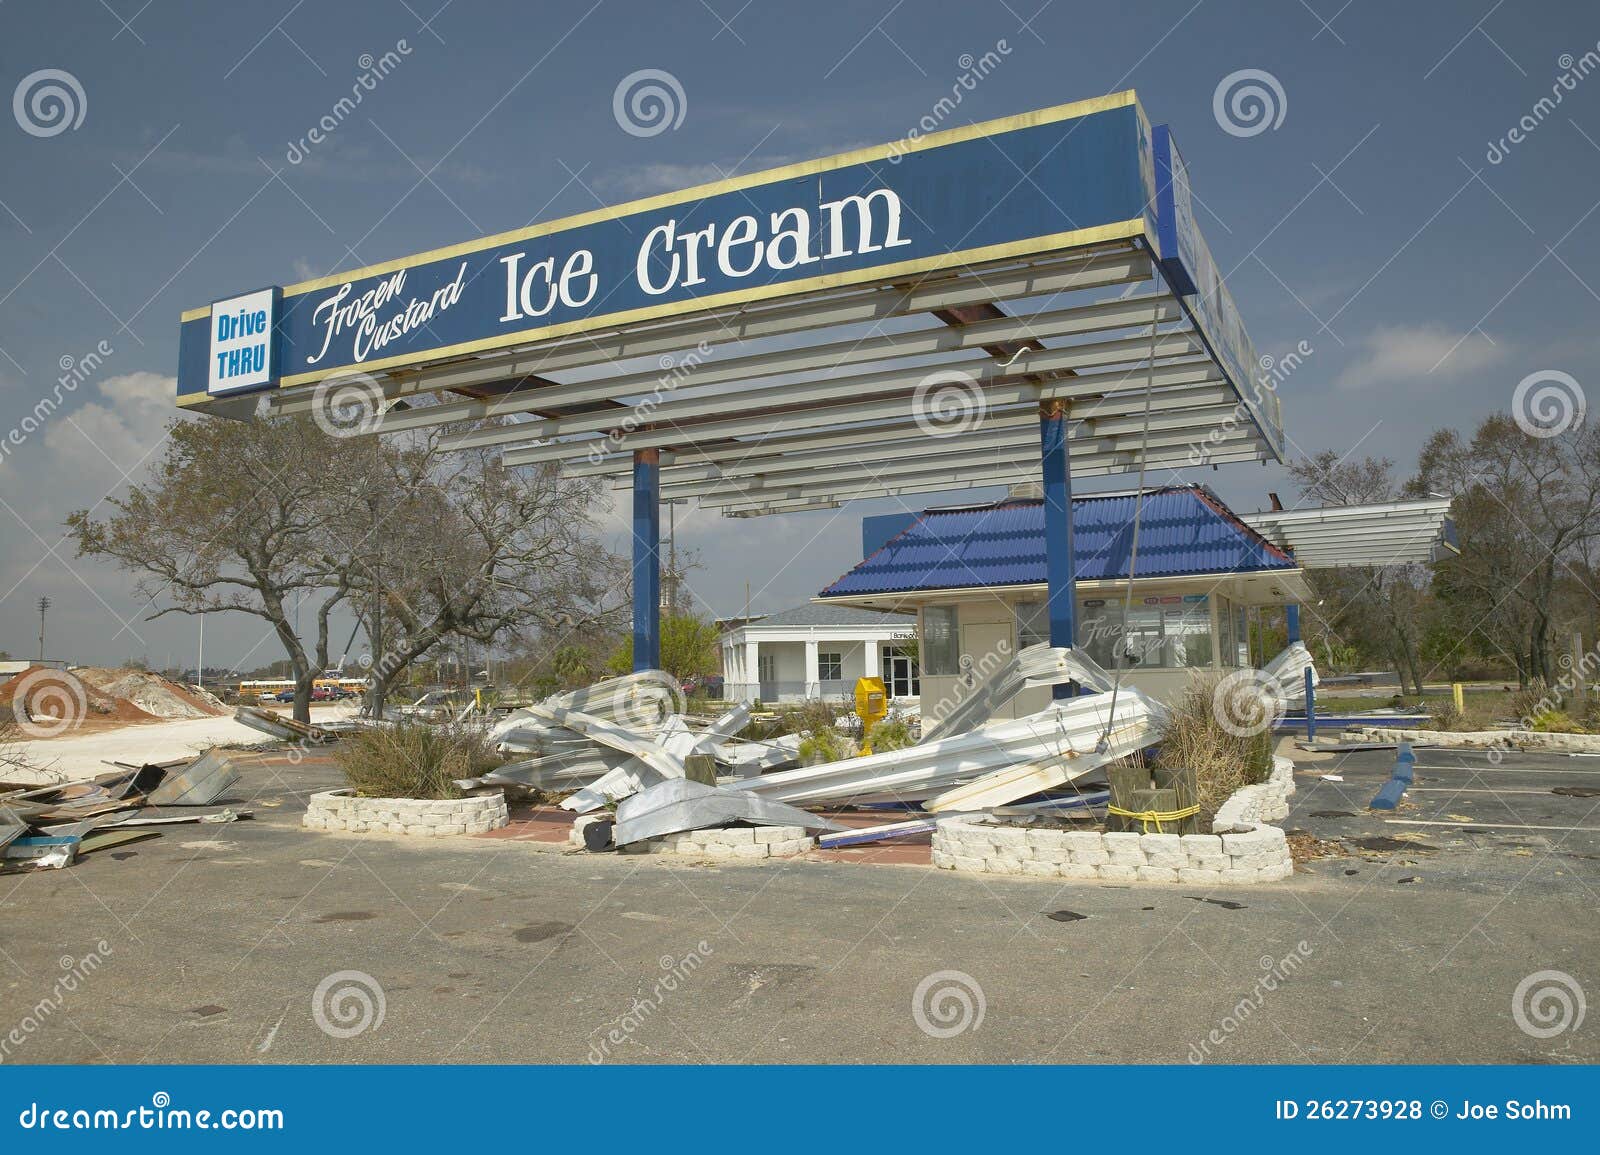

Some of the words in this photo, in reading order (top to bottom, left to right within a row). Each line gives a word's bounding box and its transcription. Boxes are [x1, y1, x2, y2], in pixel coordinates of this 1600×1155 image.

[500, 249, 598, 322] Ice
[636, 188, 911, 295] Cream
[218, 309, 266, 342] Drive
[307, 268, 407, 364] Frozen
[354, 261, 468, 362] Custard
[217, 344, 265, 379] THRU
